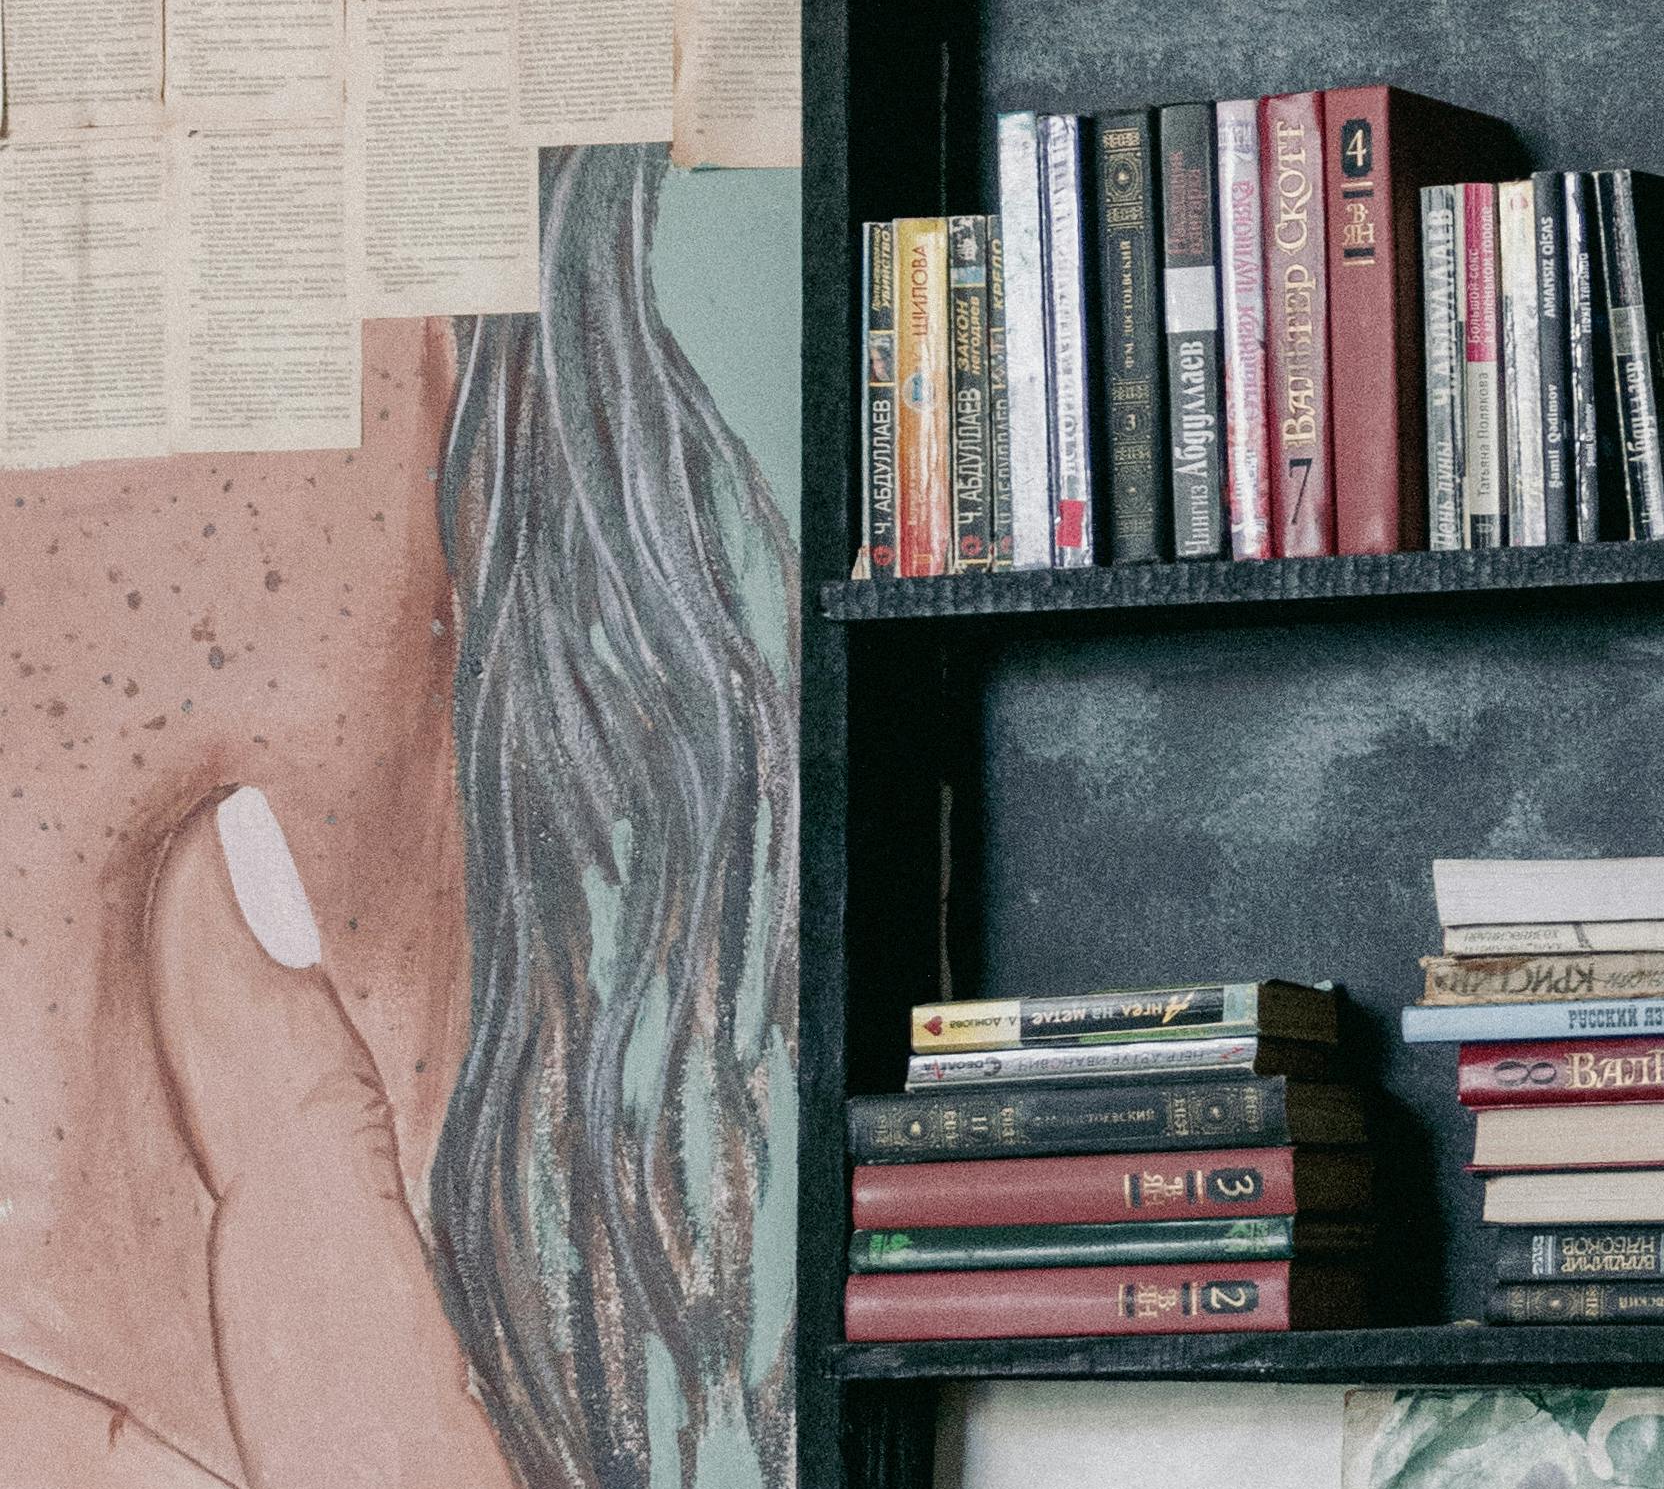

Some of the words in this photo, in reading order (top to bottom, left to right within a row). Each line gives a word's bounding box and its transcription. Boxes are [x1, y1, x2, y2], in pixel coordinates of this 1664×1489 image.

[1345, 128, 1368, 168] 4
[1274, 120, 1313, 256] СКОТТ
[880, 229, 892, 309] УБИЙСТВО
[910, 245, 929, 338] ШИЛОВА
[1118, 240, 1135, 334] ДОСТОЕВСКИЙ
[1541, 258, 1557, 319] AMANSIZ
[955, 297, 970, 372] ЗАКОН
[1466, 282, 1481, 345] Большой
[1281, 262, 1318, 450] ВАЛЬТЕР
[1125, 412, 1138, 432] 3
[1173, 339, 1215, 478] Абдуллаев
[1475, 371, 1491, 440] Полякова
[872, 398, 894, 513] АБДУЛЛАЕВ
[957, 386, 983, 503] АБДУЛЛАЕВ
[1476, 442, 1491, 498] Татьяна
[1184, 483, 1211, 556] Чингиз
[1287, 456, 1313, 526] 7
[948, 1017, 1000, 1031] Донцова
[1031, 1008, 1086, 1026] метле
[1090, 1007, 1117, 1020] на
[1119, 991, 1196, 1024] Ангел
[1567, 1005, 1639, 1030] РУССКИЙ
[1493, 1059, 1558, 1088] 8
[1216, 1174, 1255, 1197] 3
[1559, 1253, 1656, 1273] ВЛАДИМИР
[1560, 1235, 1656, 1255] НАБОКОВ
[1209, 1286, 1247, 1310] 2
